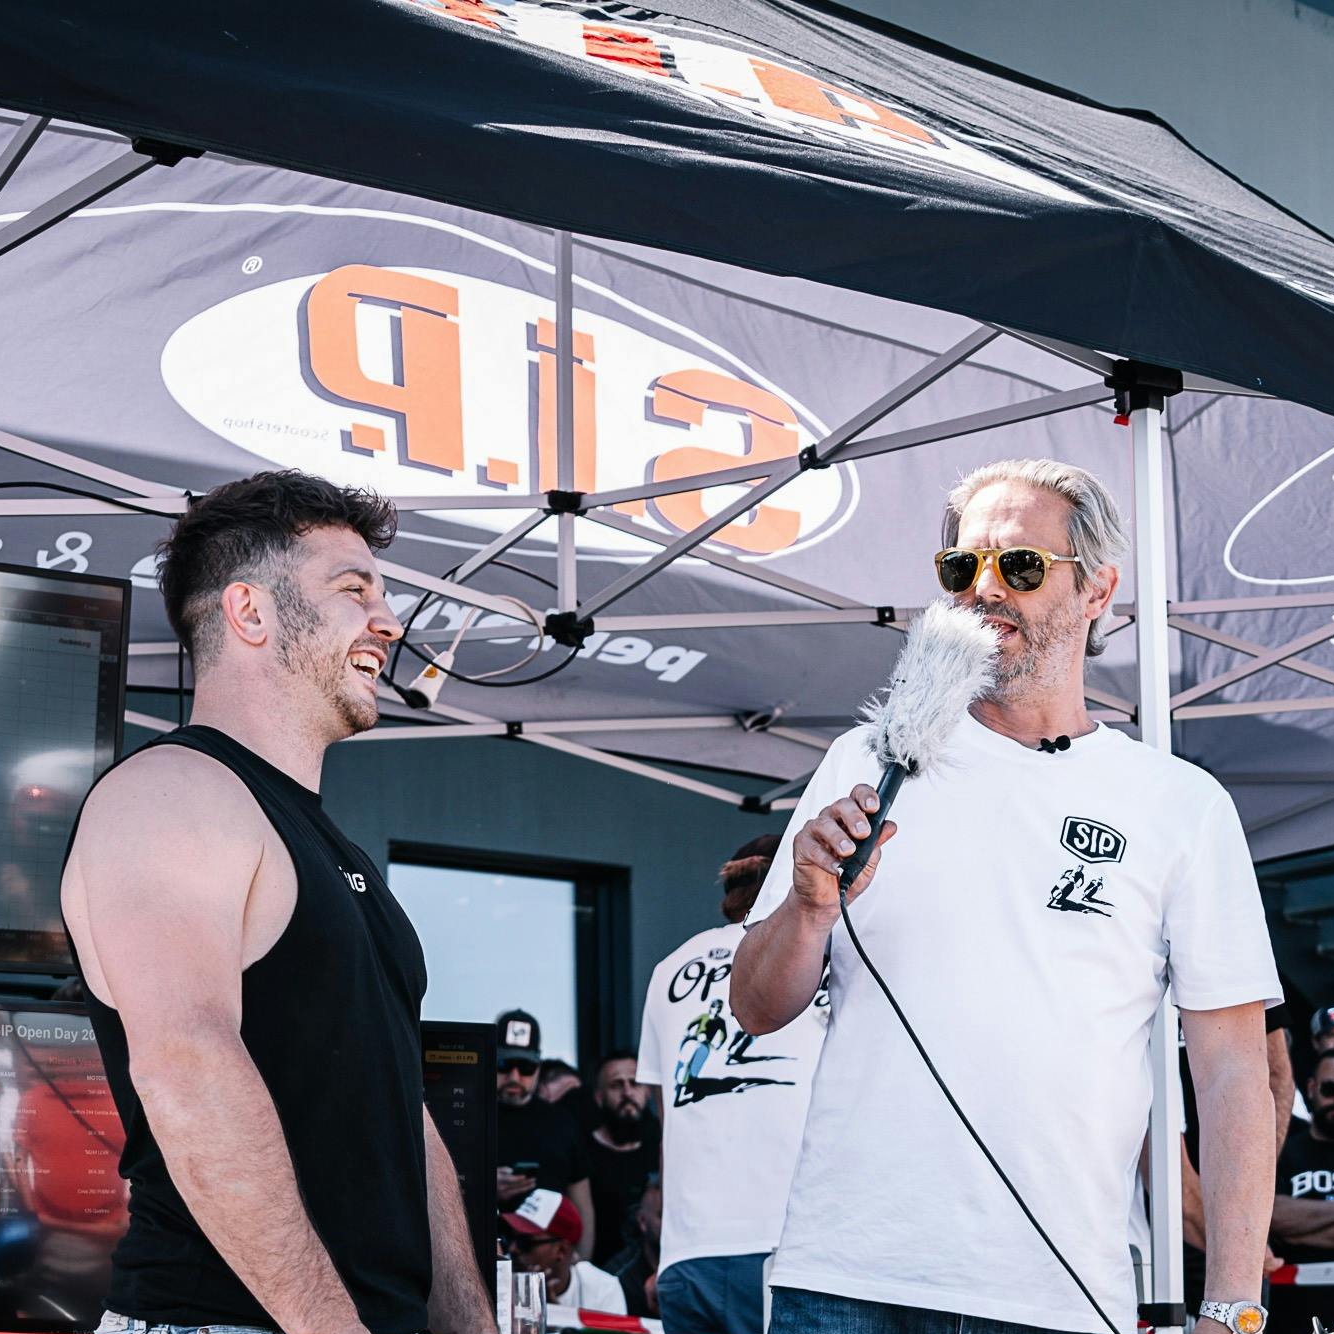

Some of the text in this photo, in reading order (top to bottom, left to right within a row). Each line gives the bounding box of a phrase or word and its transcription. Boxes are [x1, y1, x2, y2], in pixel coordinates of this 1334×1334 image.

[1073, 823, 1116, 855] SIP
[17, 1025, 50, 1040] Open
[54, 1027, 78, 1043] Day
[0, 1071, 16, 1079] NAME
